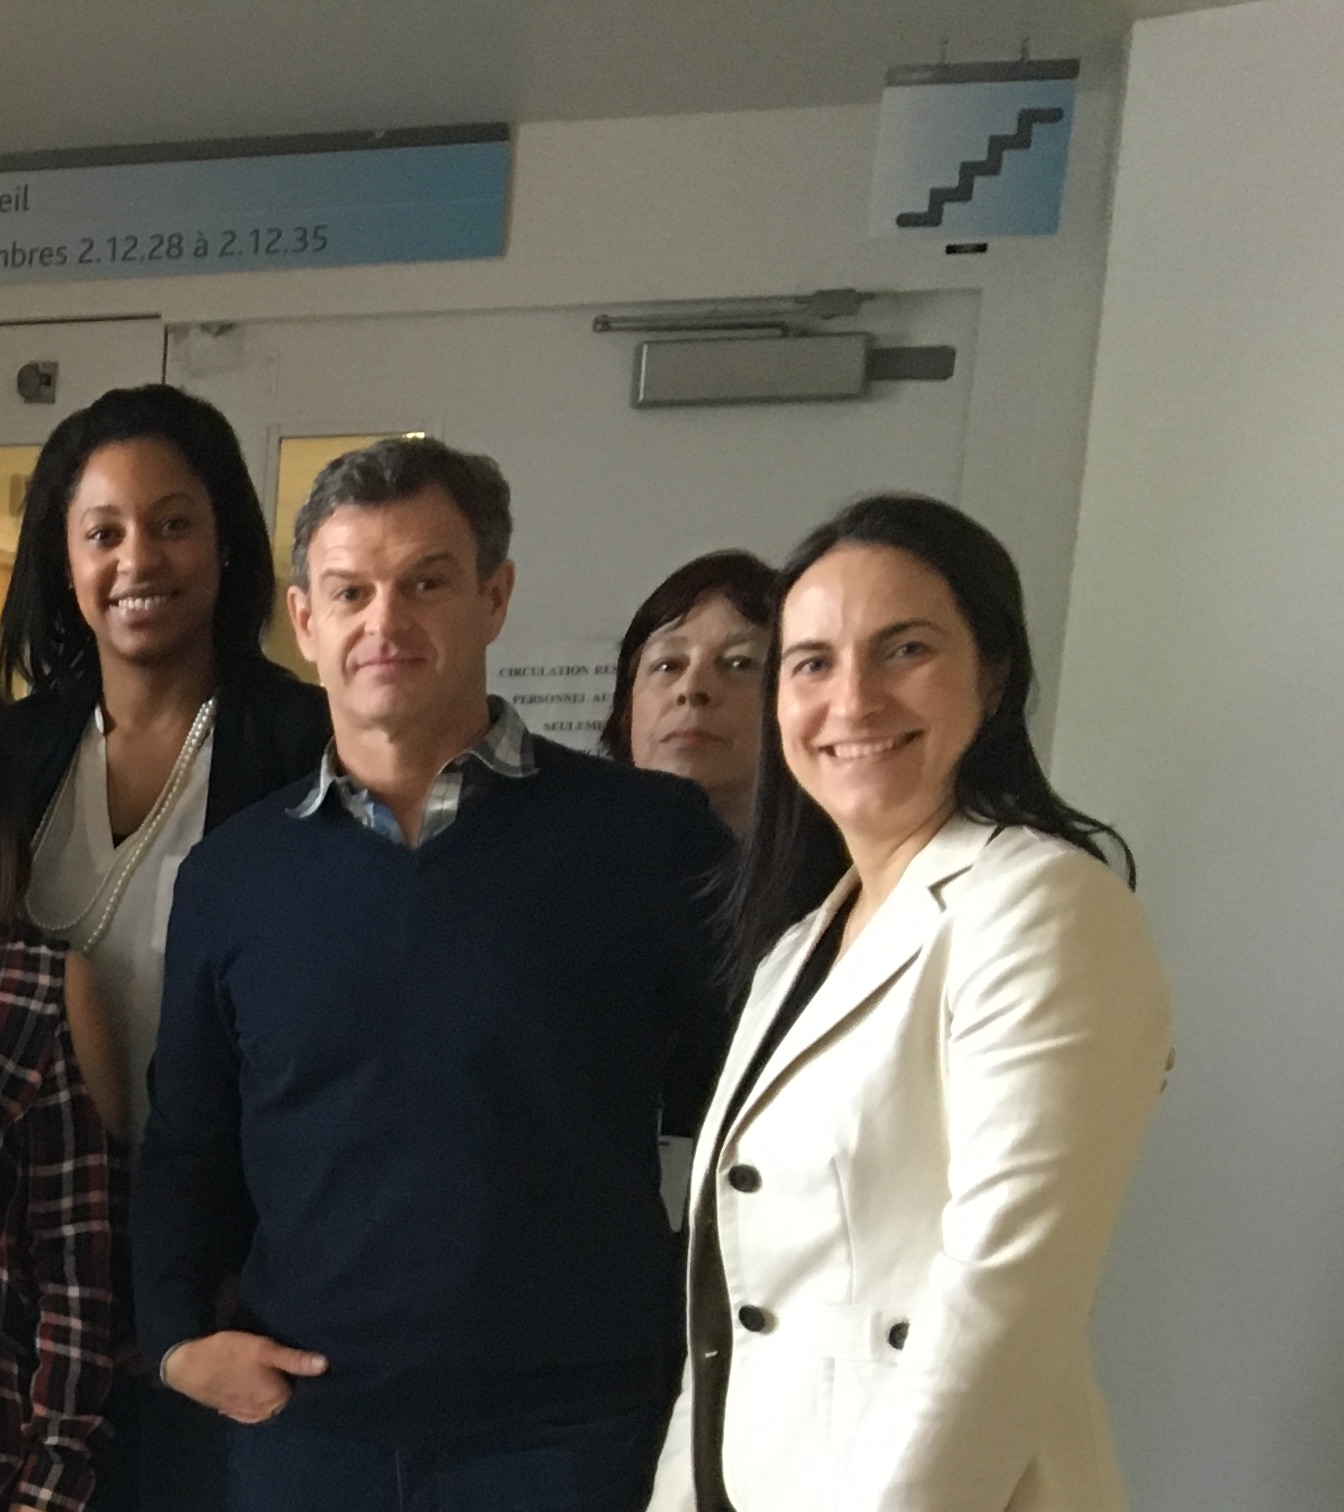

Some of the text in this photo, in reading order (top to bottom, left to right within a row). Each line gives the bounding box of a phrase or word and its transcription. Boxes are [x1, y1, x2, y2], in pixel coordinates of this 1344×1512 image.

[77, 232, 184, 264] 2.12.28
[193, 231, 209, 258] à
[219, 225, 329, 257] 2.12.35
[499, 665, 589, 677] CIRCULATION
